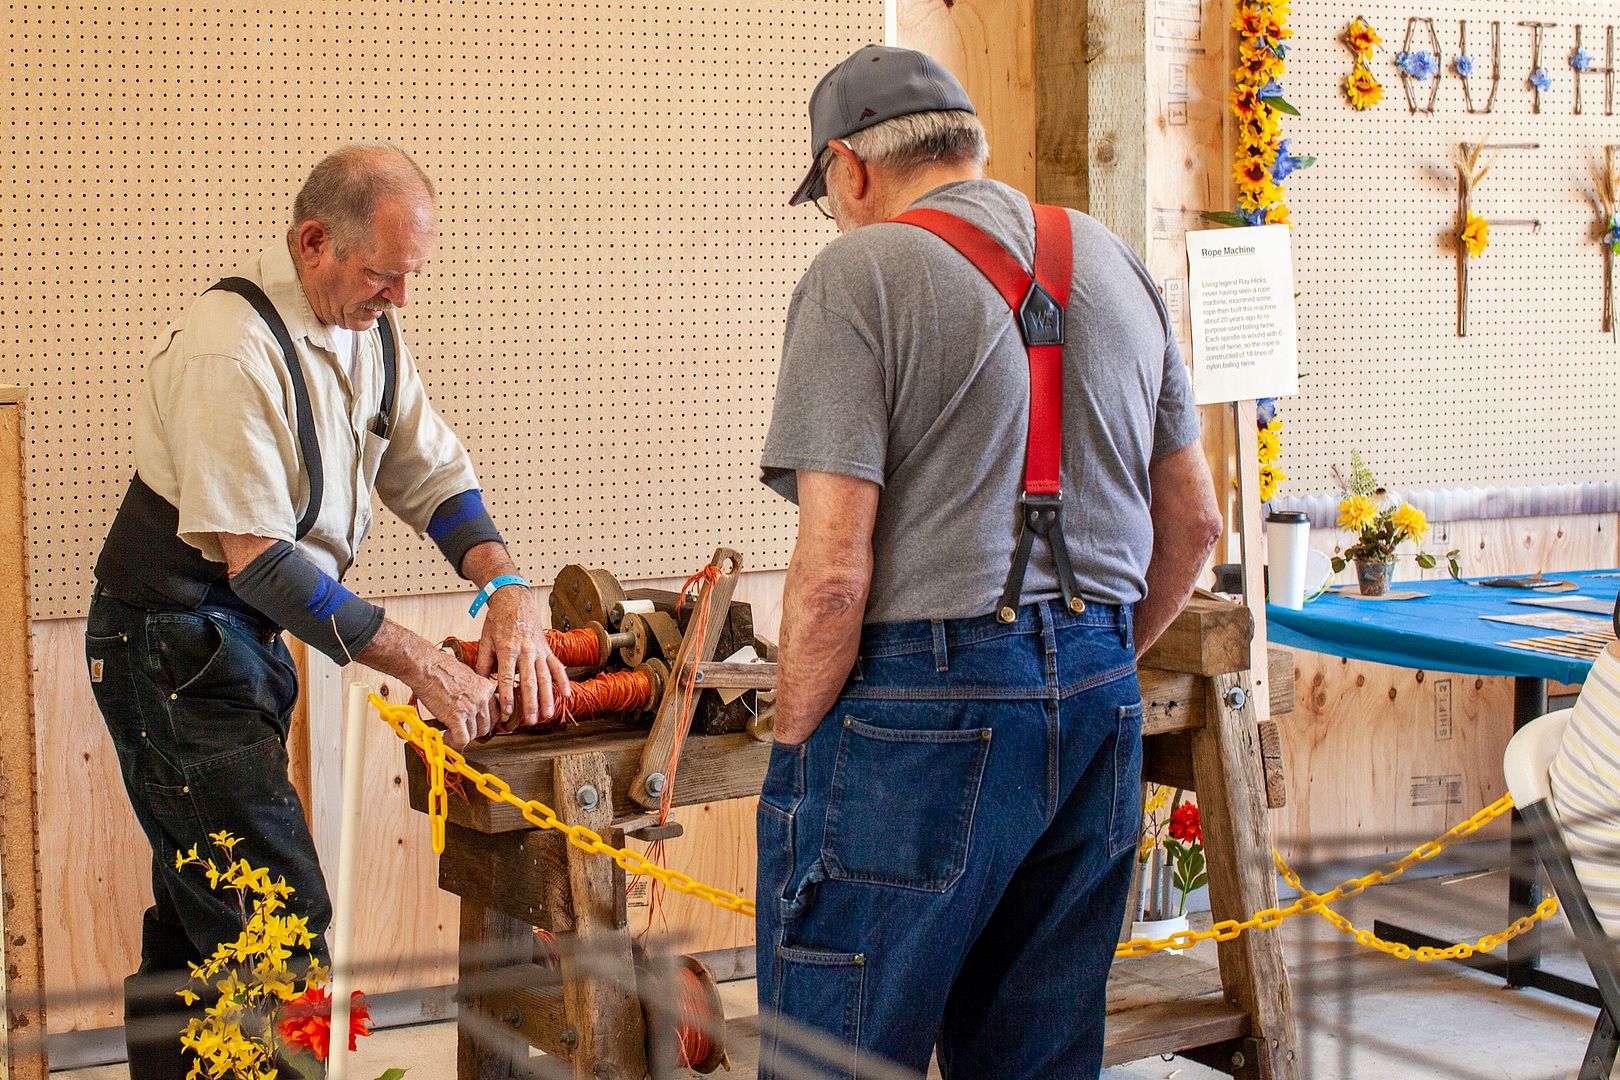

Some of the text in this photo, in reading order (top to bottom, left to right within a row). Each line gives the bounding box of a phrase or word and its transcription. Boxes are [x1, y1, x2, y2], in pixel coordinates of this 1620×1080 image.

[1201, 244, 1256, 258] Rope Machine
[1202, 281, 1218, 289] Living
[1219, 279, 1238, 287] legend
[1239, 278, 1250, 286] Ray
[1219, 288, 1237, 296] having
[1242, 323, 1259, 331] baling
[1221, 333, 1240, 341] spindle
[1206, 352, 1239, 360] constructed
[1206, 363, 1222, 371] nylon
[1222, 361, 1240, 369] baling
[1440, 684, 1447, 692] 2
